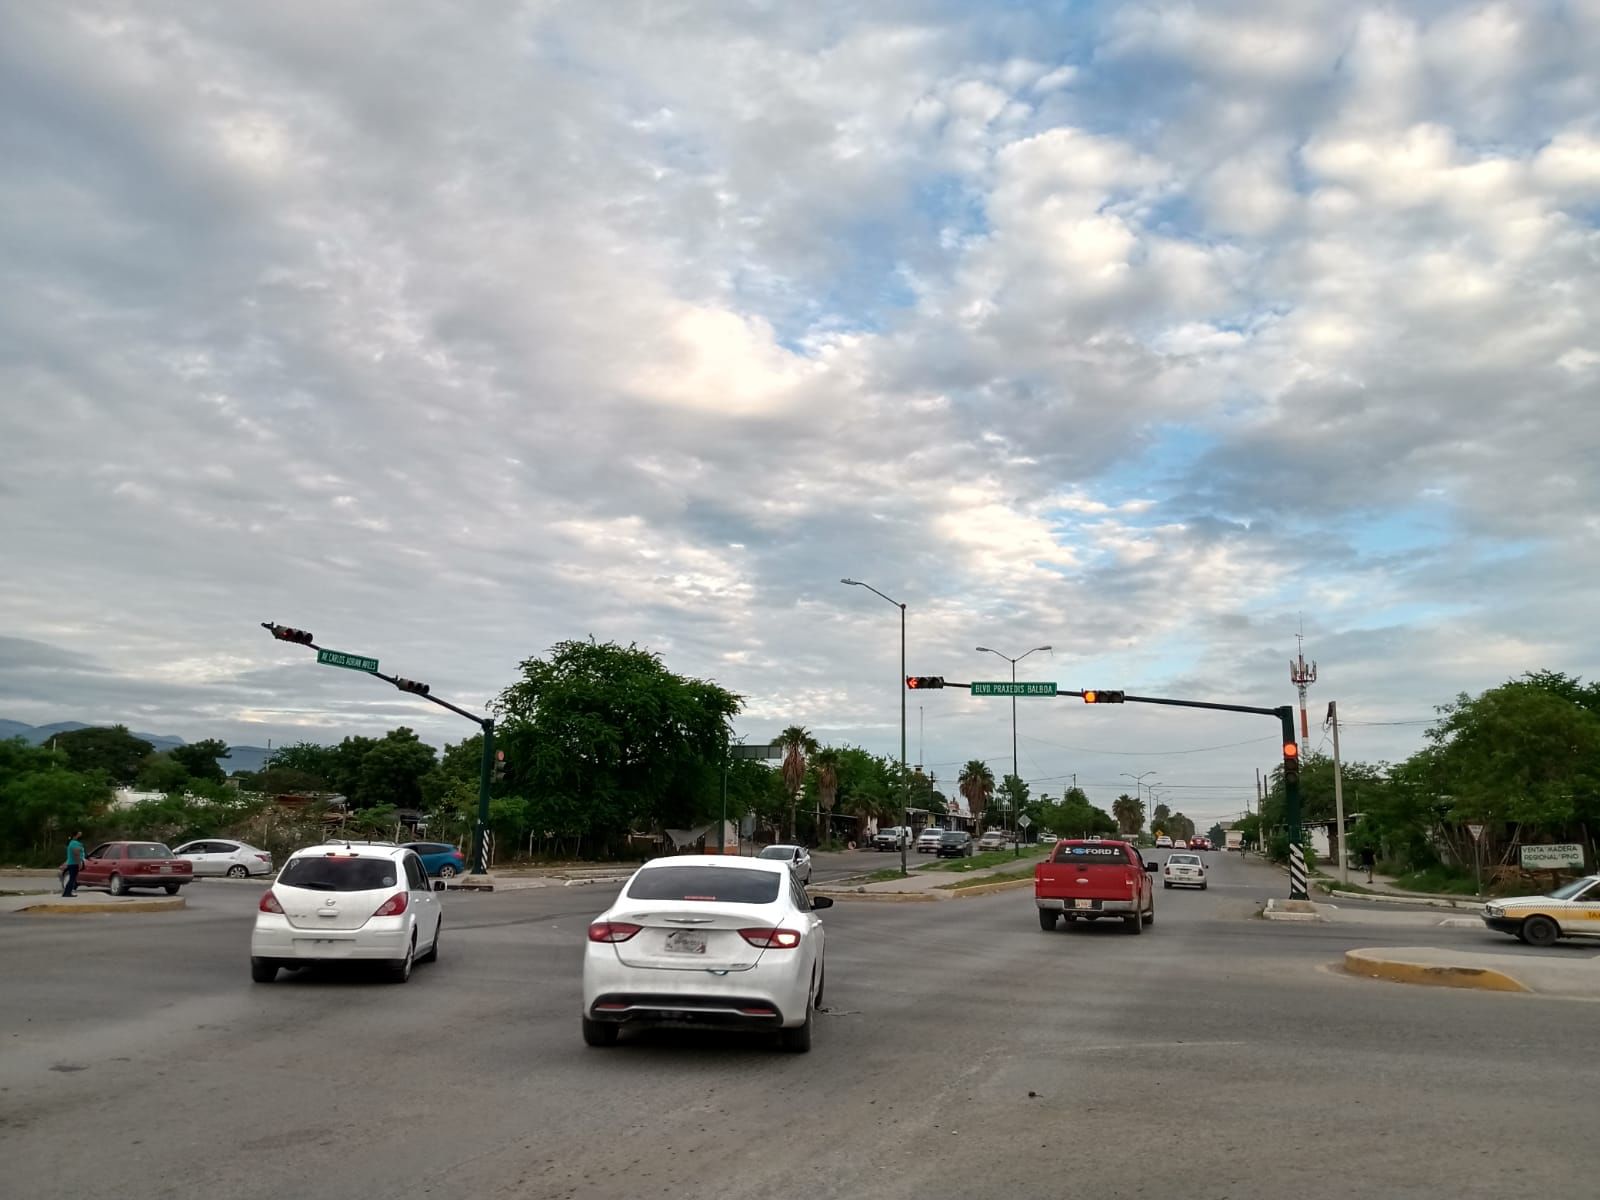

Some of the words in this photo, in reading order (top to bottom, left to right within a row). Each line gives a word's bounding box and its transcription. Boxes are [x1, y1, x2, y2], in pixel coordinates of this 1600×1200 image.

[329, 653, 346, 665] CARLOS
[993, 684, 1025, 694] PRAXEDIS
[1027, 684, 1054, 694] BALBOA
[1587, 911, 1600, 920] TA
